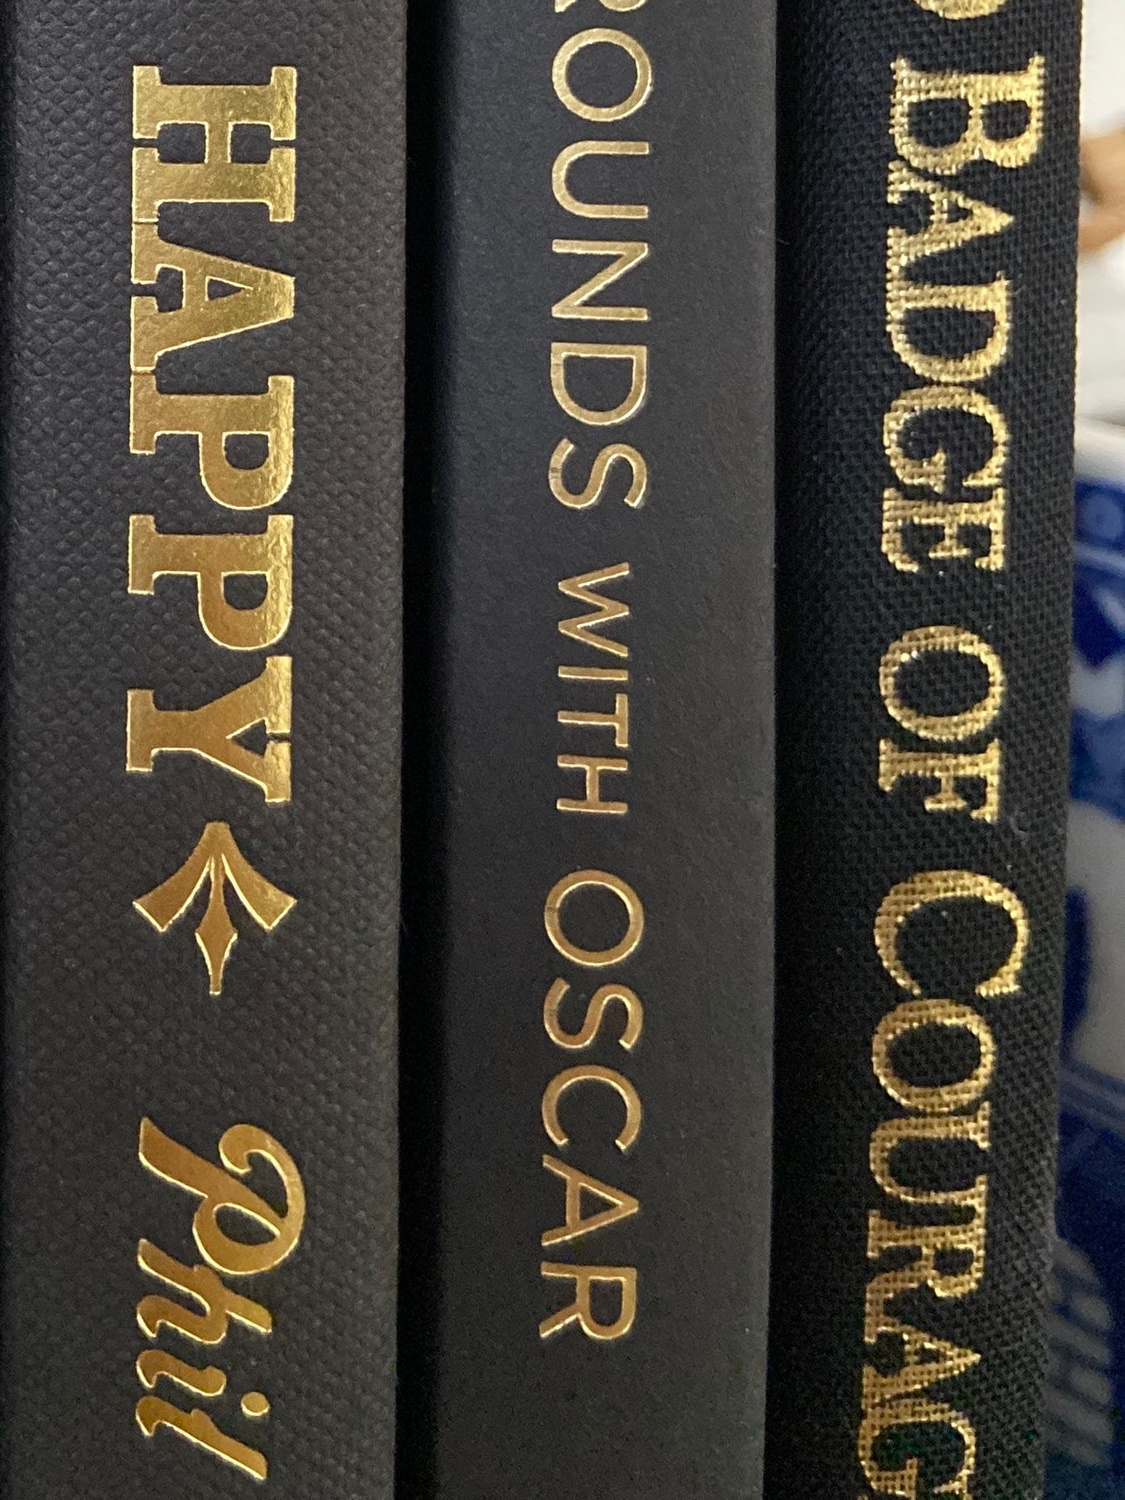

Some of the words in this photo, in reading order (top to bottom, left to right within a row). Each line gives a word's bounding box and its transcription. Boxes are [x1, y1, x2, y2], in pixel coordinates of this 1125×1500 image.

[125, 65, 297, 803] HAPPY
[881, 54, 1045, 572] BADGE
[557, 563, 630, 814] WITH
[878, 626, 1005, 821] OF
[135, 1117, 306, 1480] Phil
[540, 871, 644, 1340] OSCAR
[858, 870, 1029, 1500] COURAG
